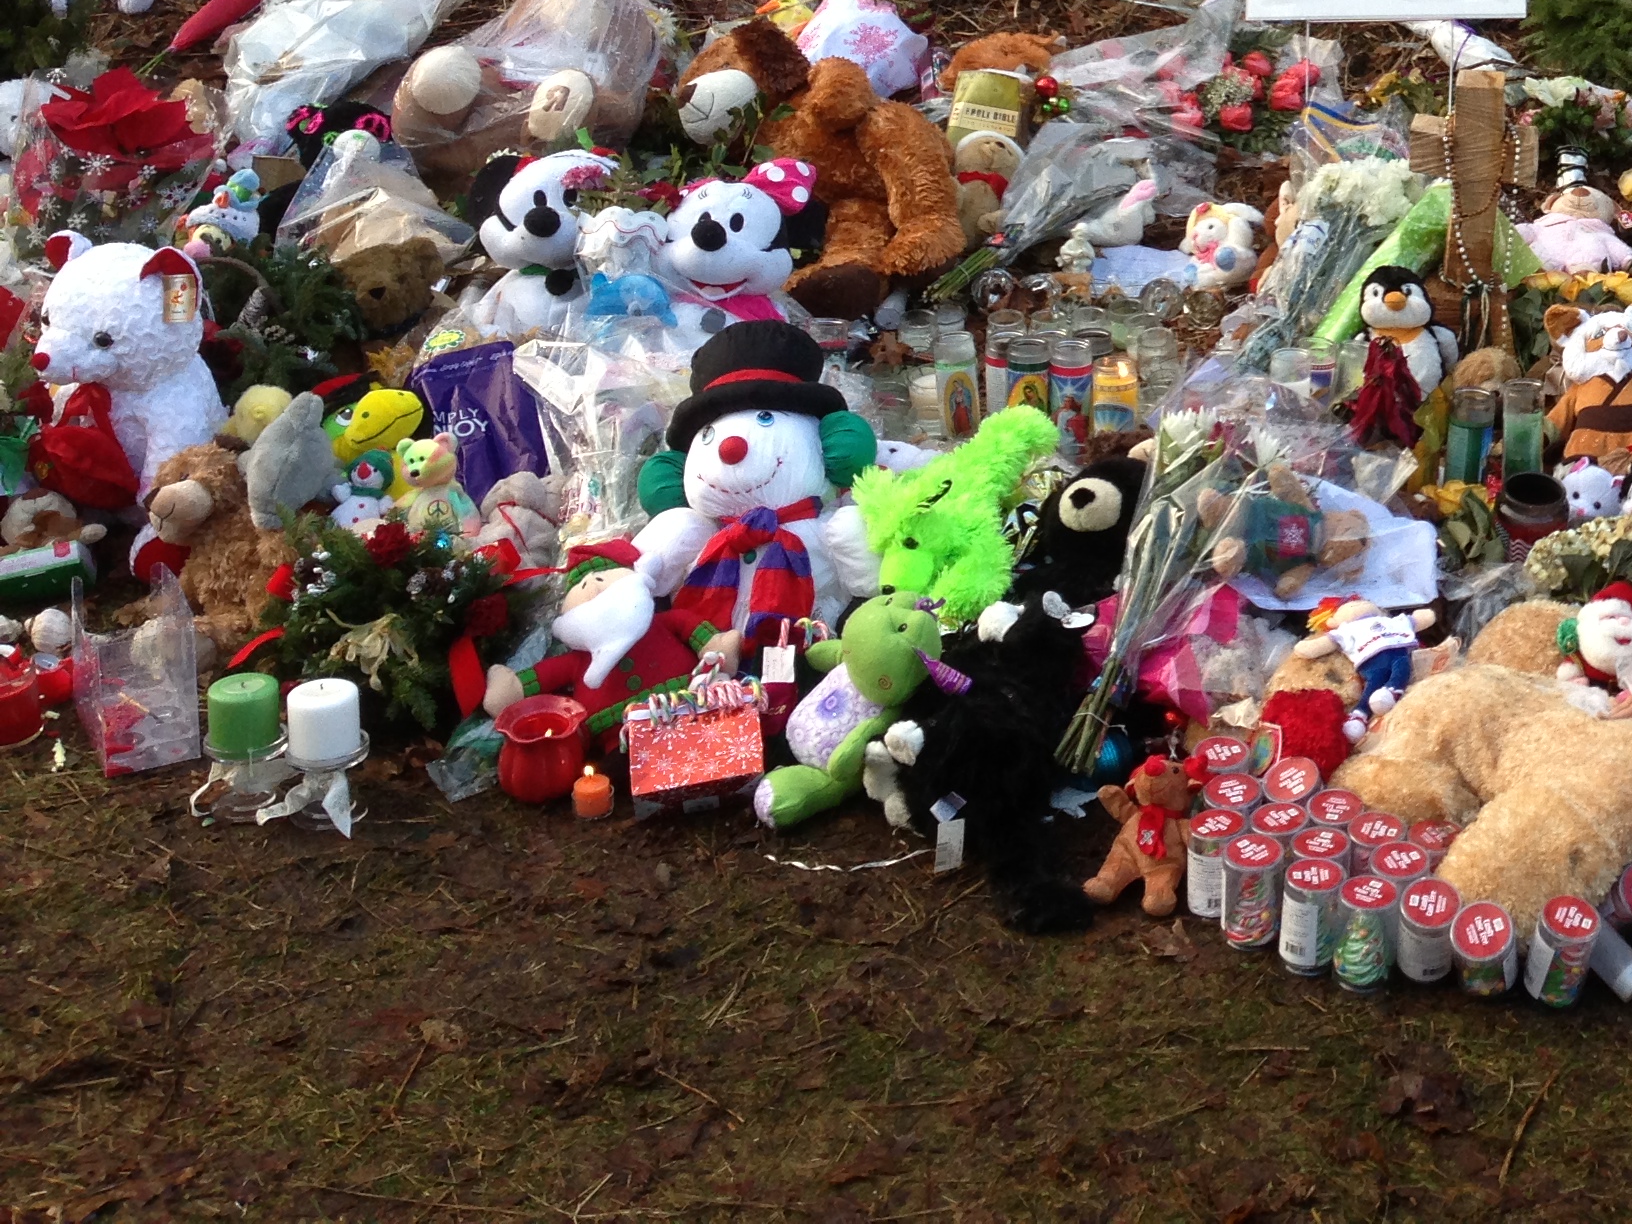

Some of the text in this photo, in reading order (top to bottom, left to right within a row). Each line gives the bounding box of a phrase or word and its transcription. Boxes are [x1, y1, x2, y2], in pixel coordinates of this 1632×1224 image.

[993, 111, 1016, 123] BIBLE
[433, 407, 480, 423] MPLY
[433, 417, 489, 437] NJOY
